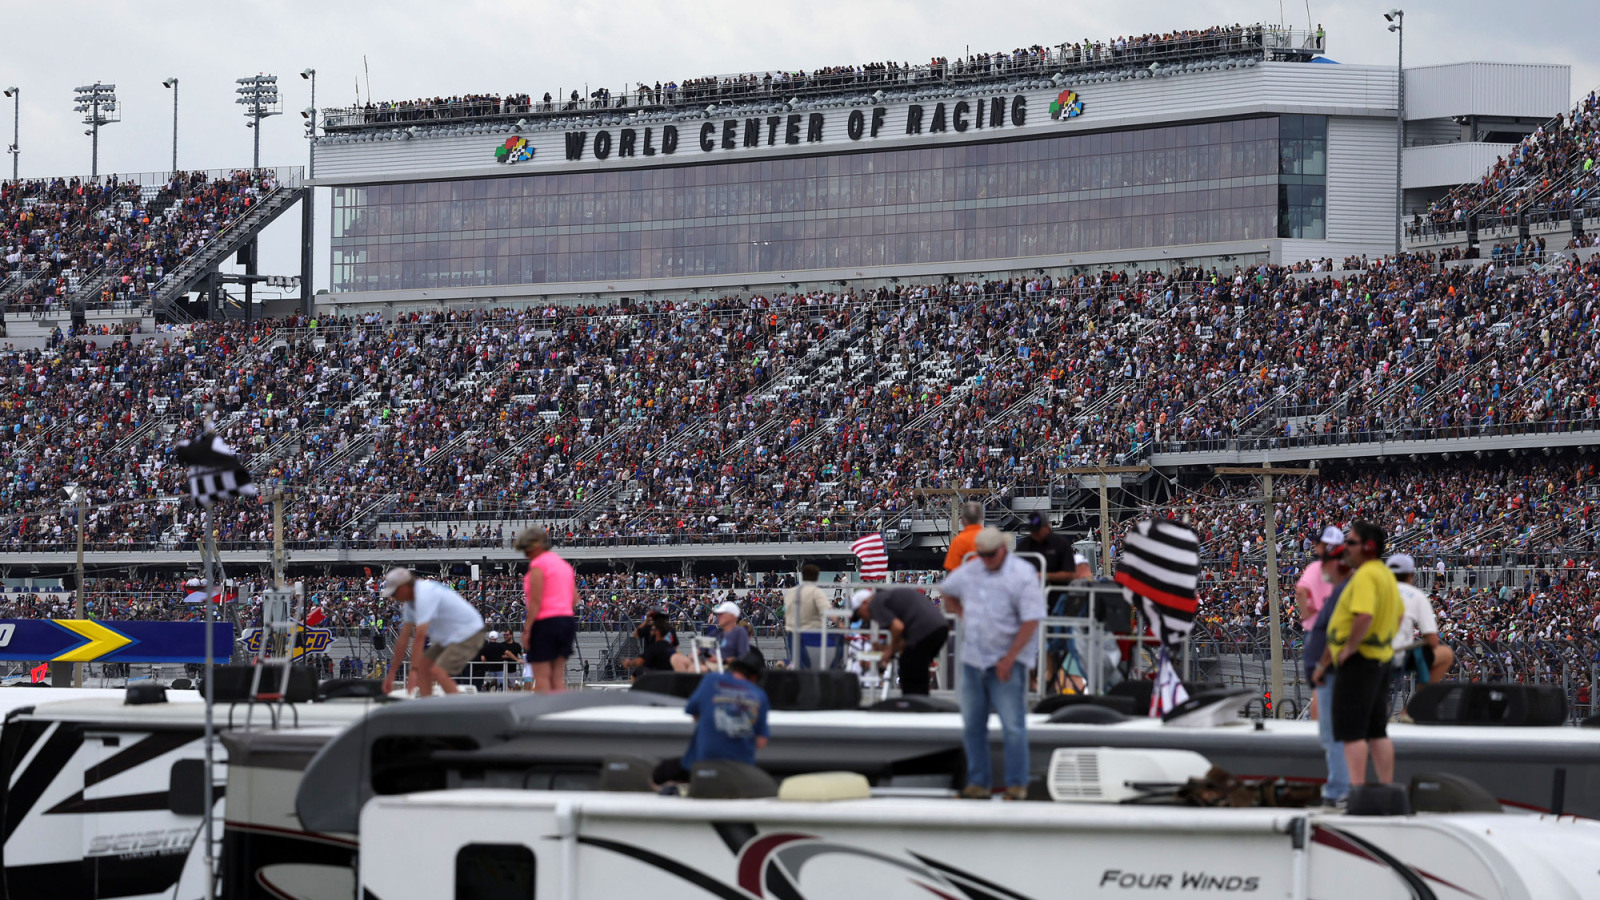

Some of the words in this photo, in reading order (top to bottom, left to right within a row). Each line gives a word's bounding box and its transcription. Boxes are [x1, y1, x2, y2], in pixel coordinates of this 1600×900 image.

[565, 125, 678, 160] WORLD
[700, 113, 824, 152] CENTER
[848, 107, 886, 140] OF
[906, 95, 1026, 135] RACING
[88, 828, 198, 854] SEISM
[1099, 869, 1173, 890] FOUR
[1180, 871, 1260, 892] WINDS
